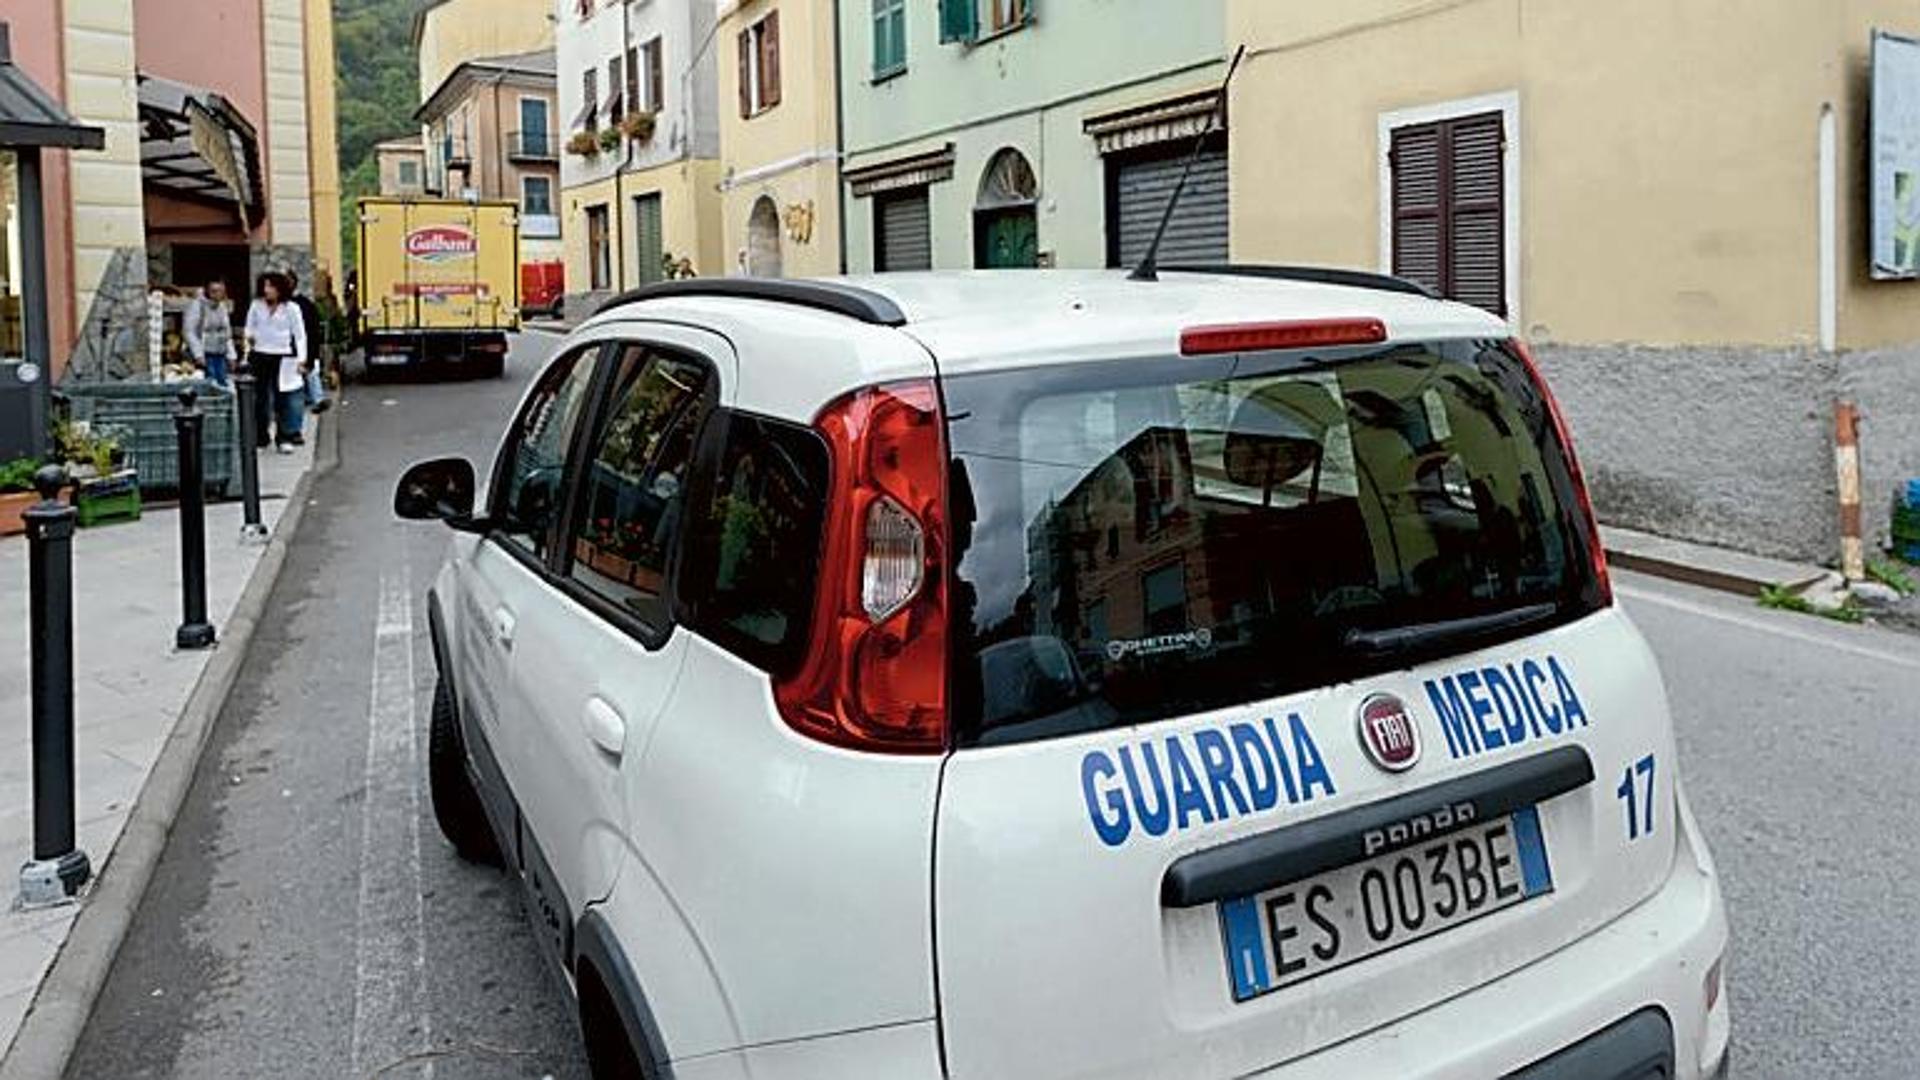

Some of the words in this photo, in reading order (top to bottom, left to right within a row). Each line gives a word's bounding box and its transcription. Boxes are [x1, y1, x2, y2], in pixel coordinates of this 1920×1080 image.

[408, 233, 472, 251] Galbani
[1081, 713, 1335, 846] GUARDIA
[1424, 656, 1588, 758] MEDICA
[1372, 712, 1412, 752] FIAT
[1617, 753, 1654, 840] 17
[1265, 884, 1341, 977] ES
[1358, 823, 1521, 943] 003BE
